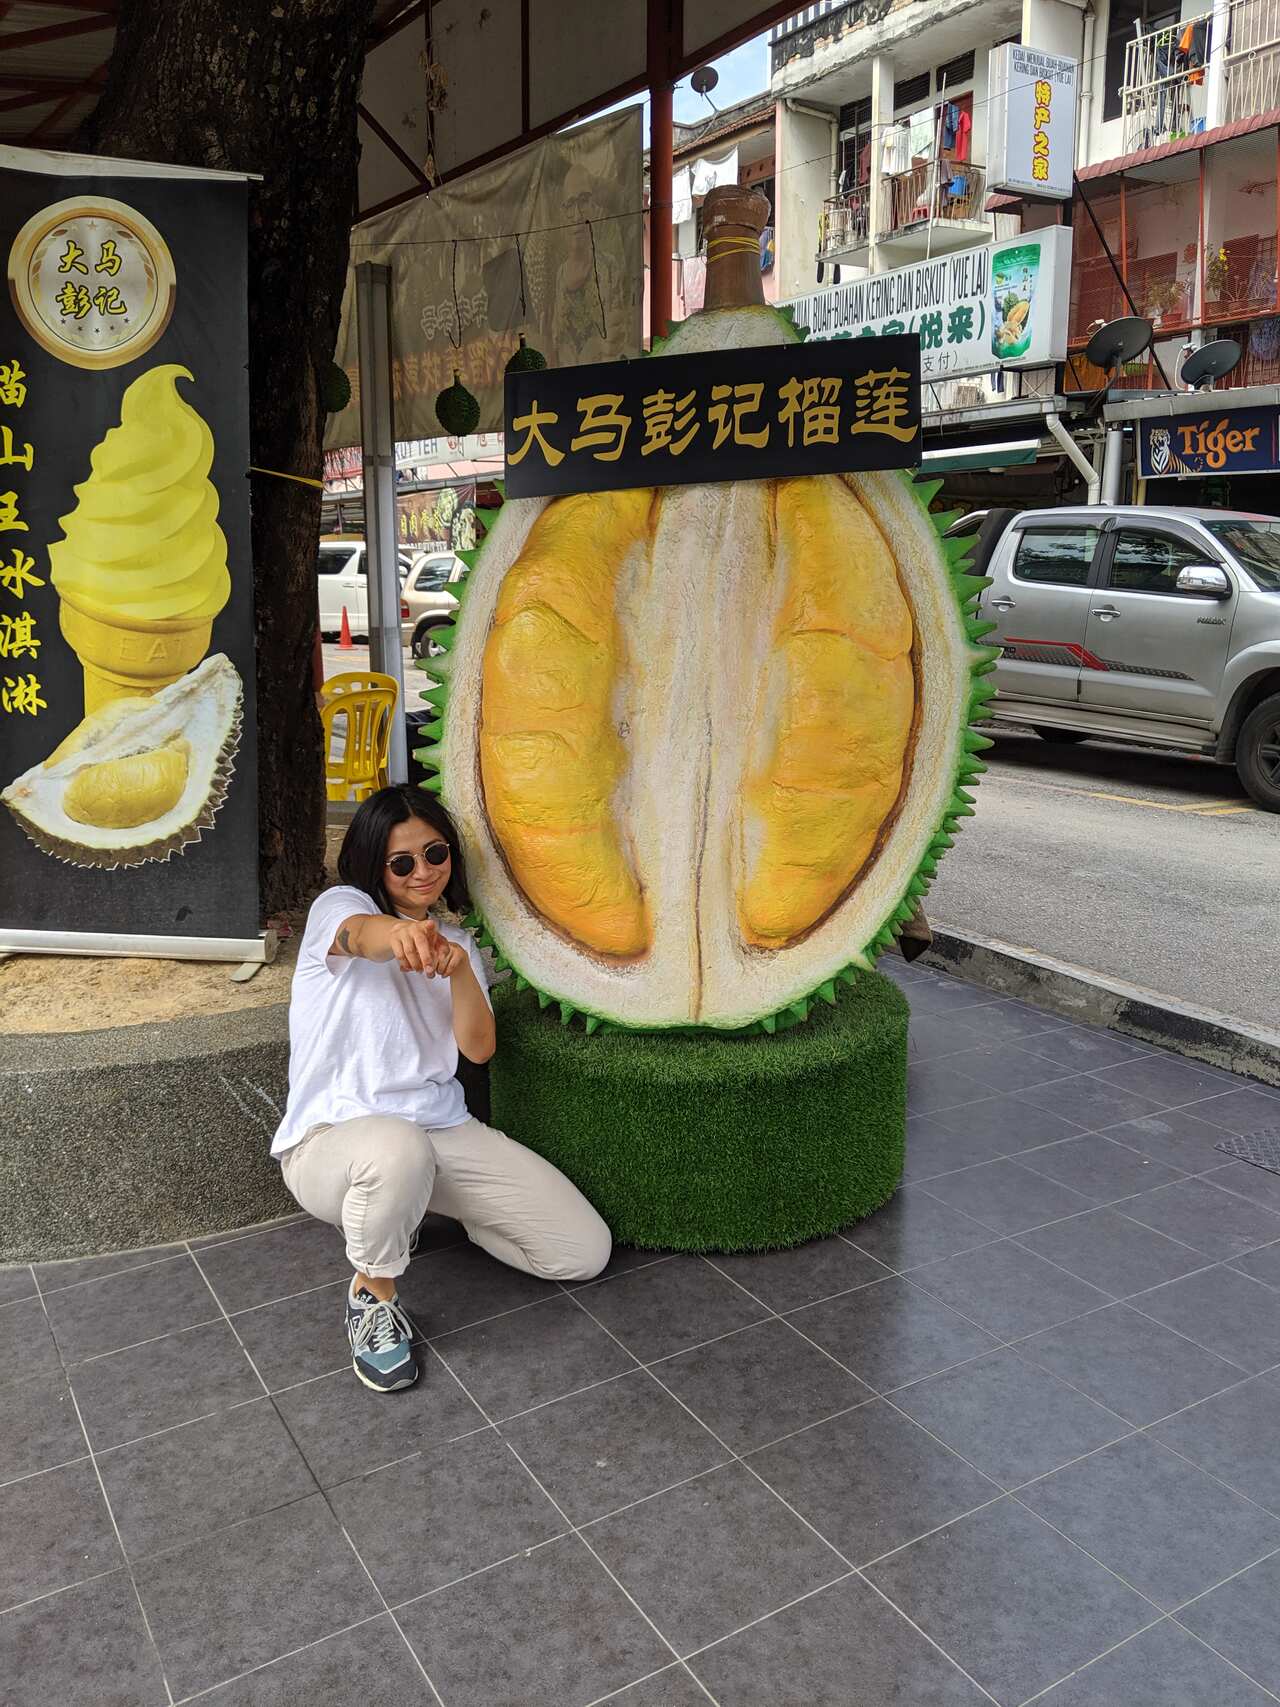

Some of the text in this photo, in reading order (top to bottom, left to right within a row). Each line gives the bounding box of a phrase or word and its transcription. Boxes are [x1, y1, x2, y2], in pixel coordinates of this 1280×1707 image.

[58, 240, 122, 276] 大马
[55, 281, 127, 319] 彭记
[812, 283, 865, 333] BUAH-BUAHAN
[865, 276, 895, 321] KERING
[897, 270, 914, 315] DAN
[915, 262, 948, 310] BISKUT
[948, 254, 970, 306] (YUE
[971, 248, 990, 299] LAI)
[507, 367, 919, 467] 大马彭记榴莲
[1178, 419, 1260, 468] Tiger
